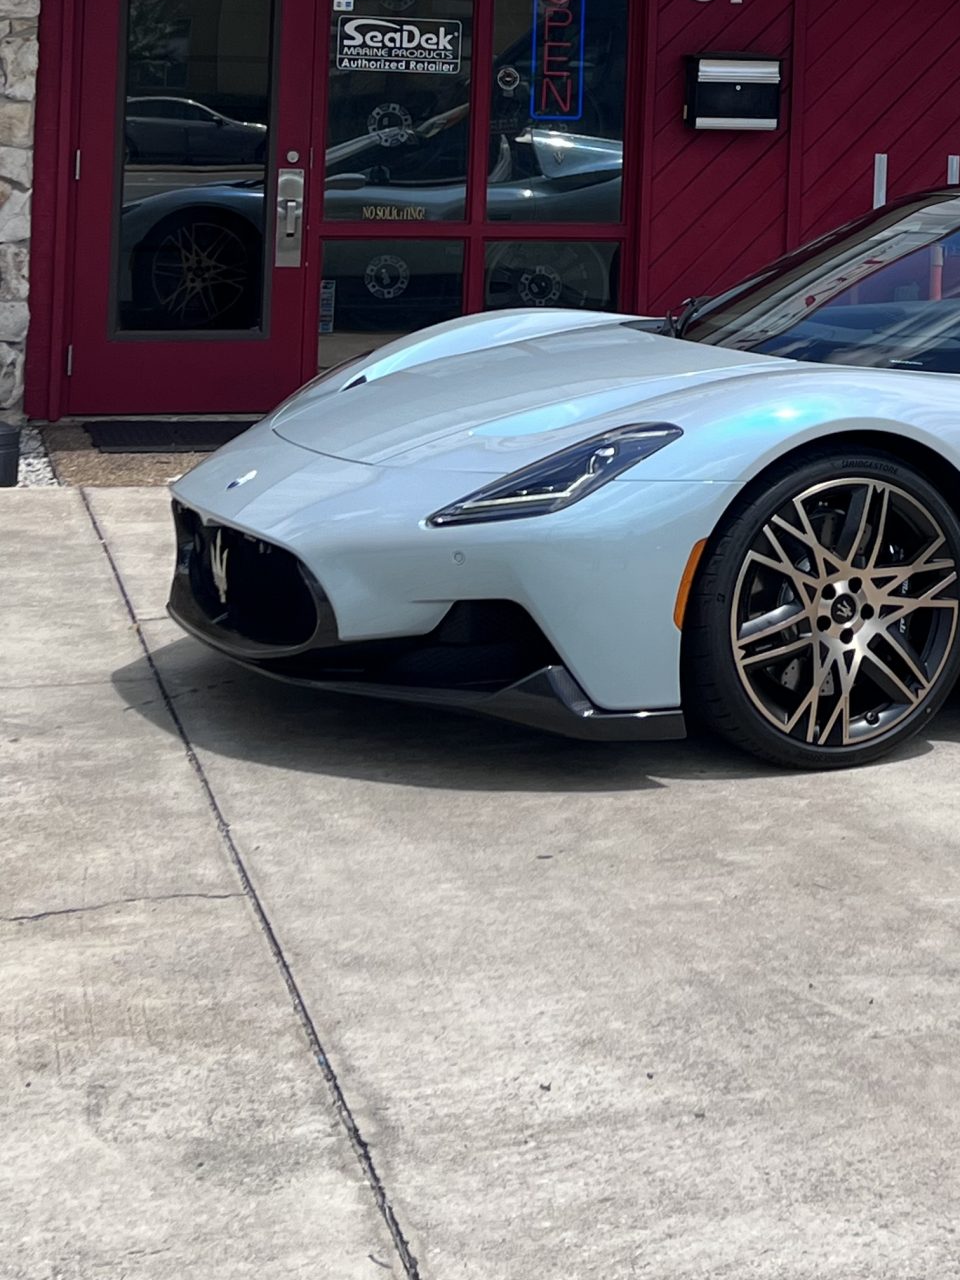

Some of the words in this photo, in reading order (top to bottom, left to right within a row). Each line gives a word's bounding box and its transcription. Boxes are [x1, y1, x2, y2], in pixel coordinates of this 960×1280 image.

[343, 18, 454, 50] SeaDek
[342, 46, 389, 57] MARINE
[391, 49, 454, 60] PRODUCTS
[341, 57, 406, 70] Authorized
[409, 60, 455, 73] Retailer
[362, 206, 376, 220] NO
